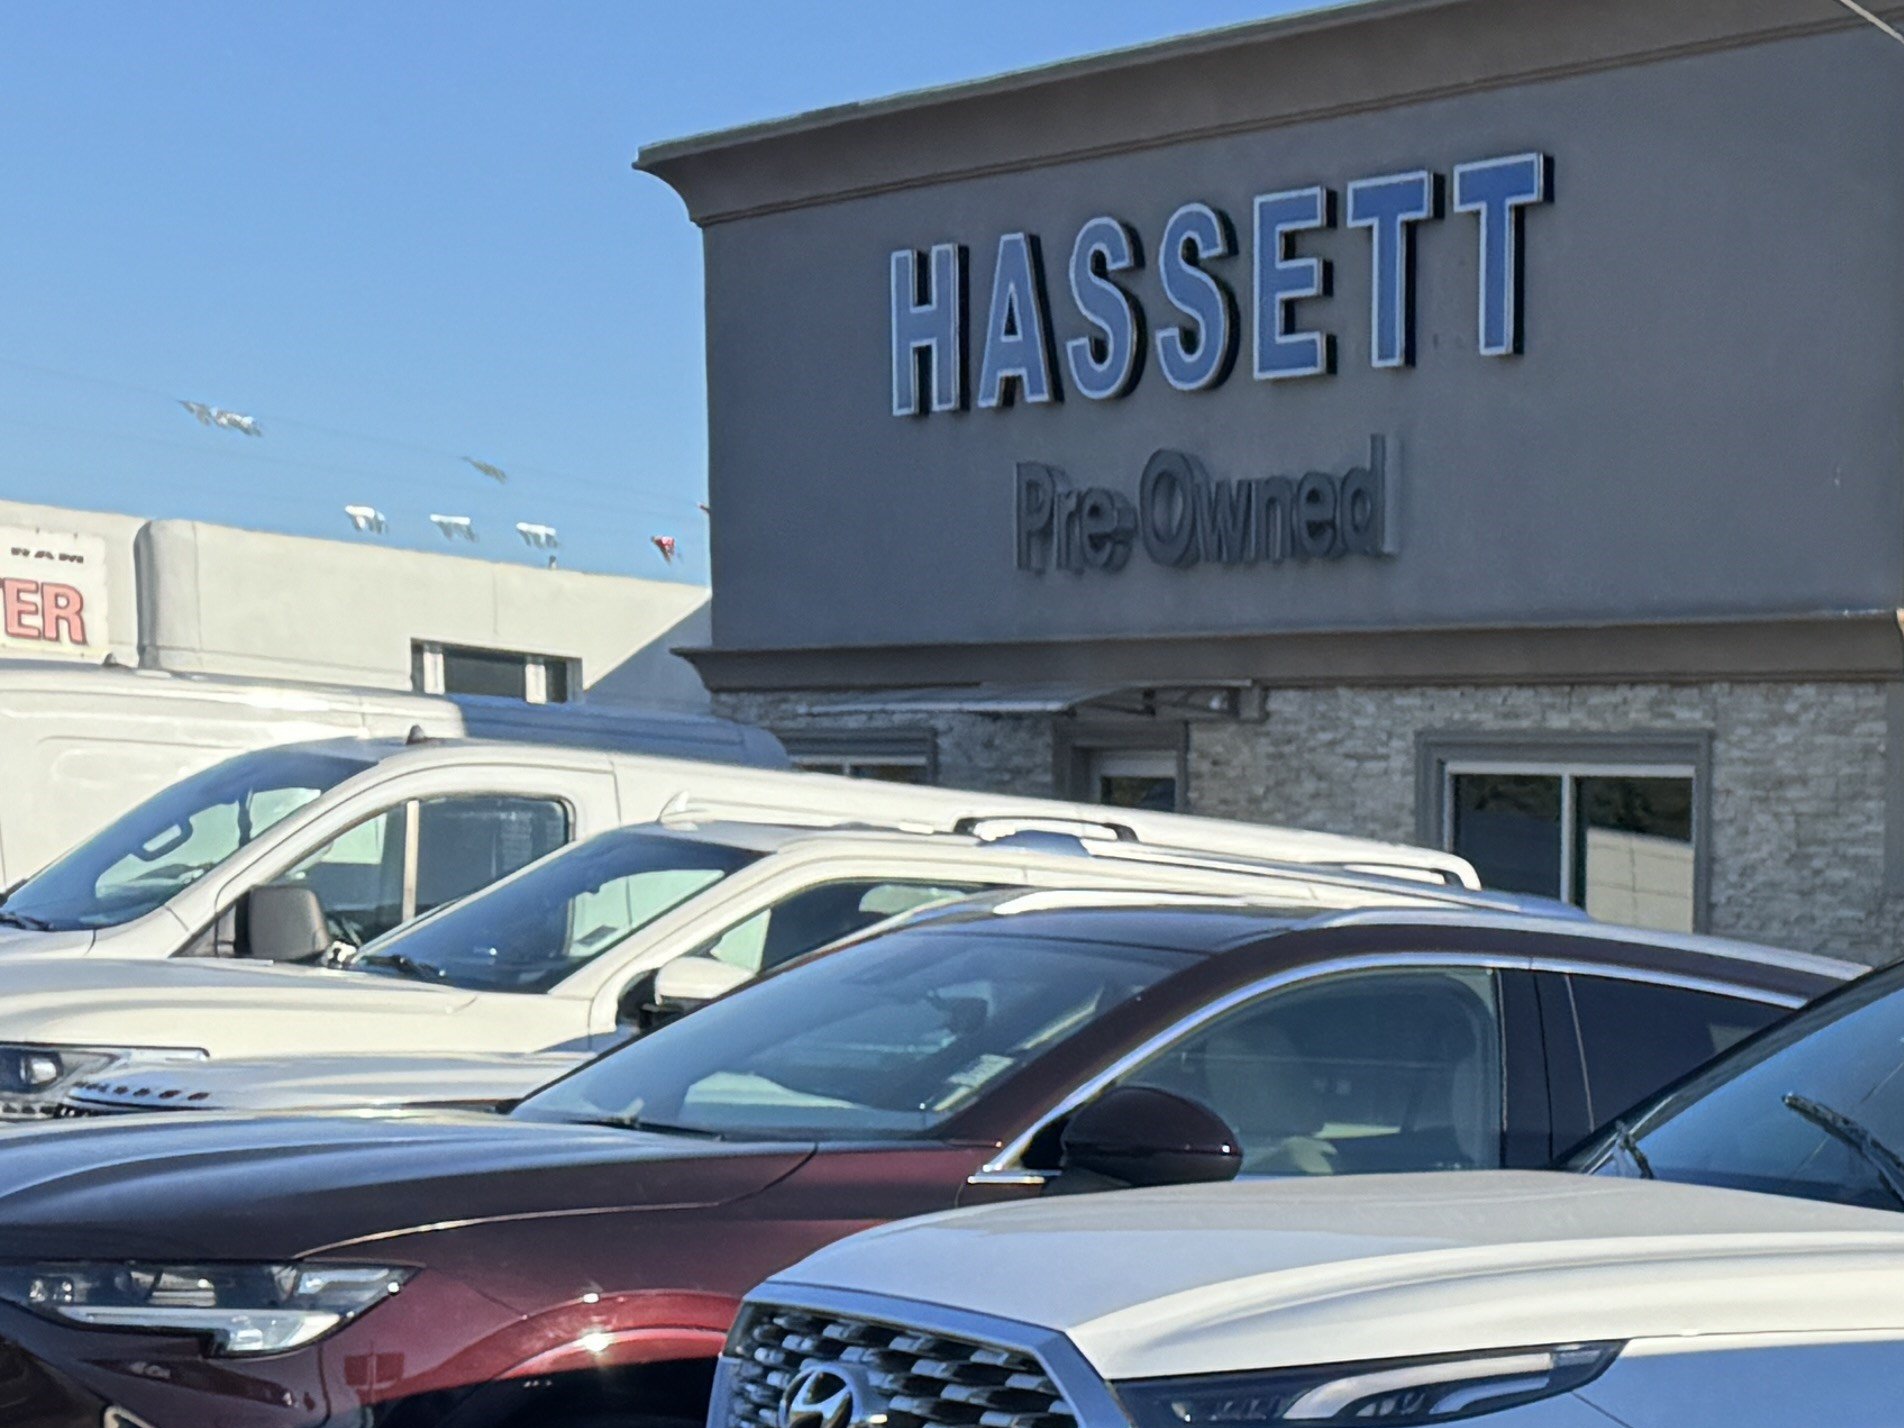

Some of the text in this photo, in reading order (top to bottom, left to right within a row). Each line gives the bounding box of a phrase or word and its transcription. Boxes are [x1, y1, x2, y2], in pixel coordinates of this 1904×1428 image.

[890, 151, 1554, 417] HASSETT
[1014, 433, 1397, 573] Pre-Owned
[0, 577, 89, 645] ER
